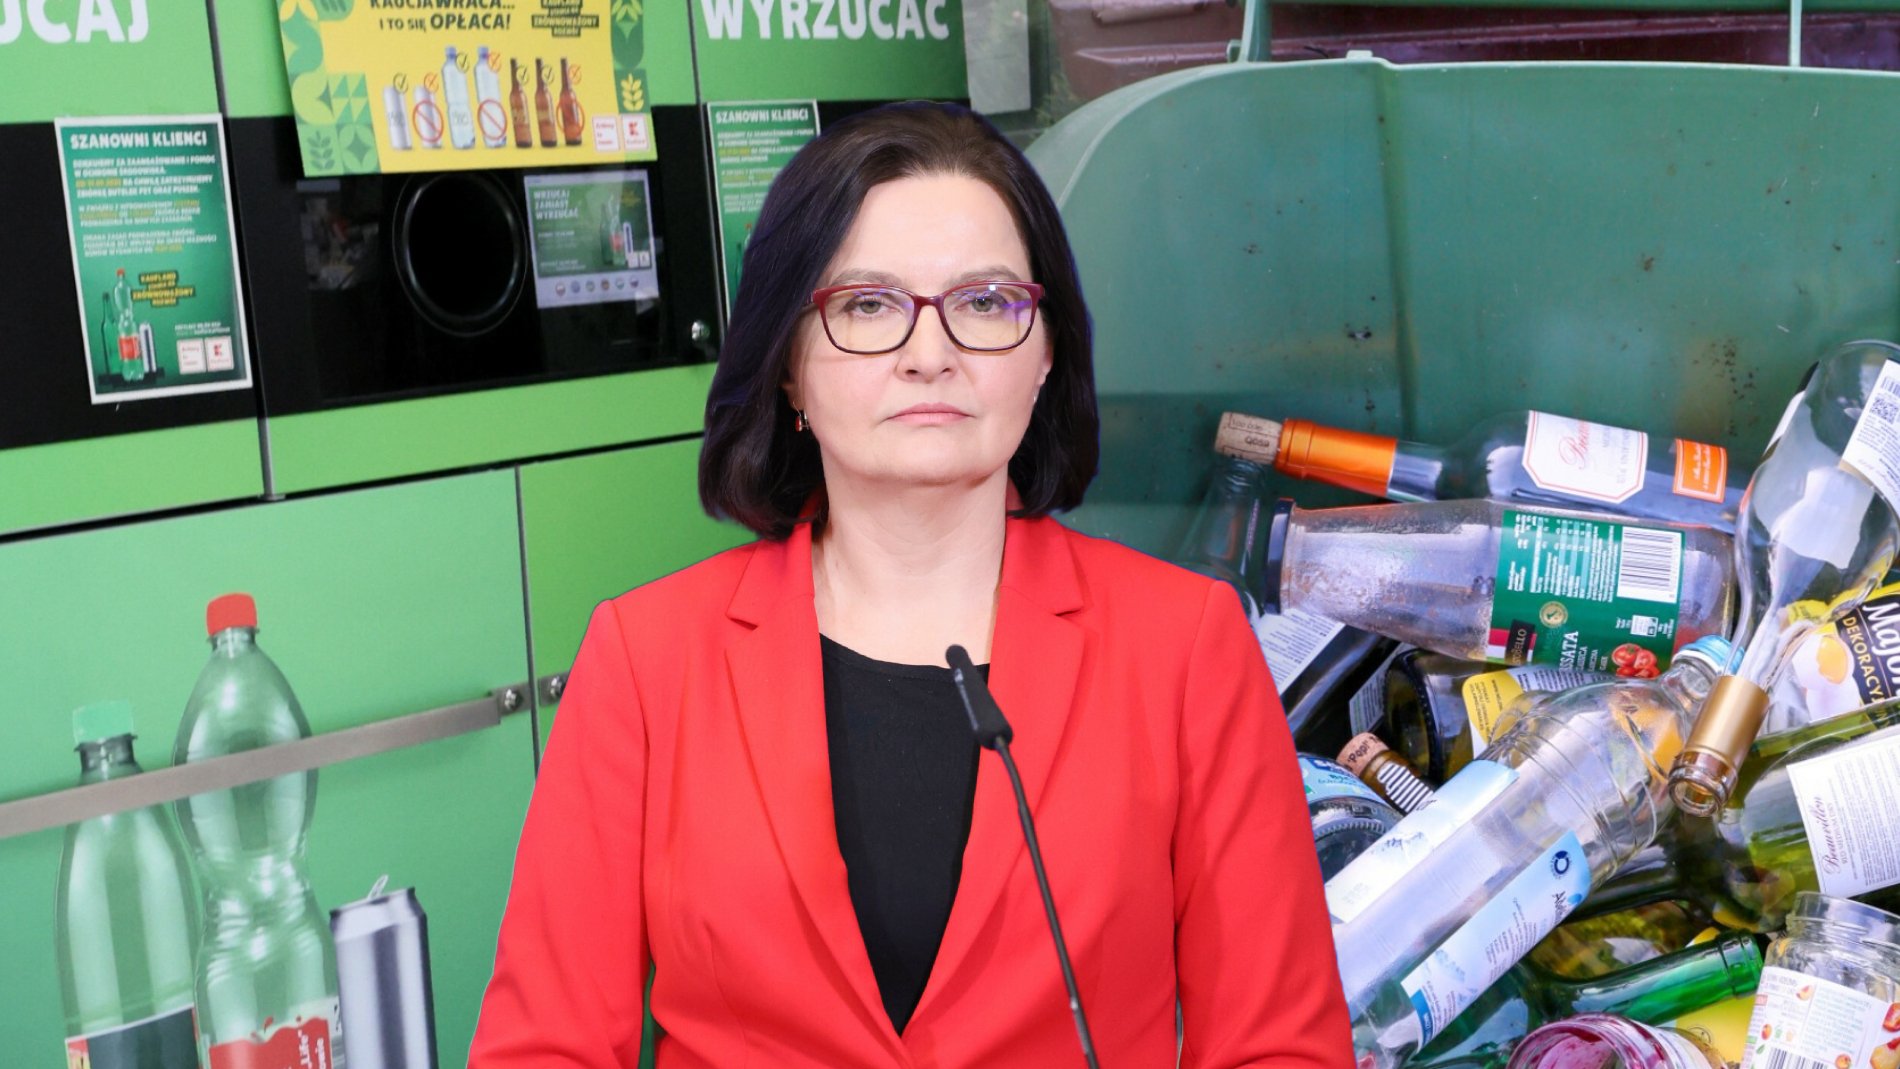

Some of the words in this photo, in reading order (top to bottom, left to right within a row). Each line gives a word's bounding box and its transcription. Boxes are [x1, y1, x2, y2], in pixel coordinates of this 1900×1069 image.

[387, 19, 404, 30] TO
[430, 13, 511, 30] OPŁACA!
[716, 110, 769, 123] SZANOWNI
[771, 108, 808, 121] KLIENCI
[70, 132, 149, 149] SZANOWNI
[153, 131, 207, 147] KLIENCI
